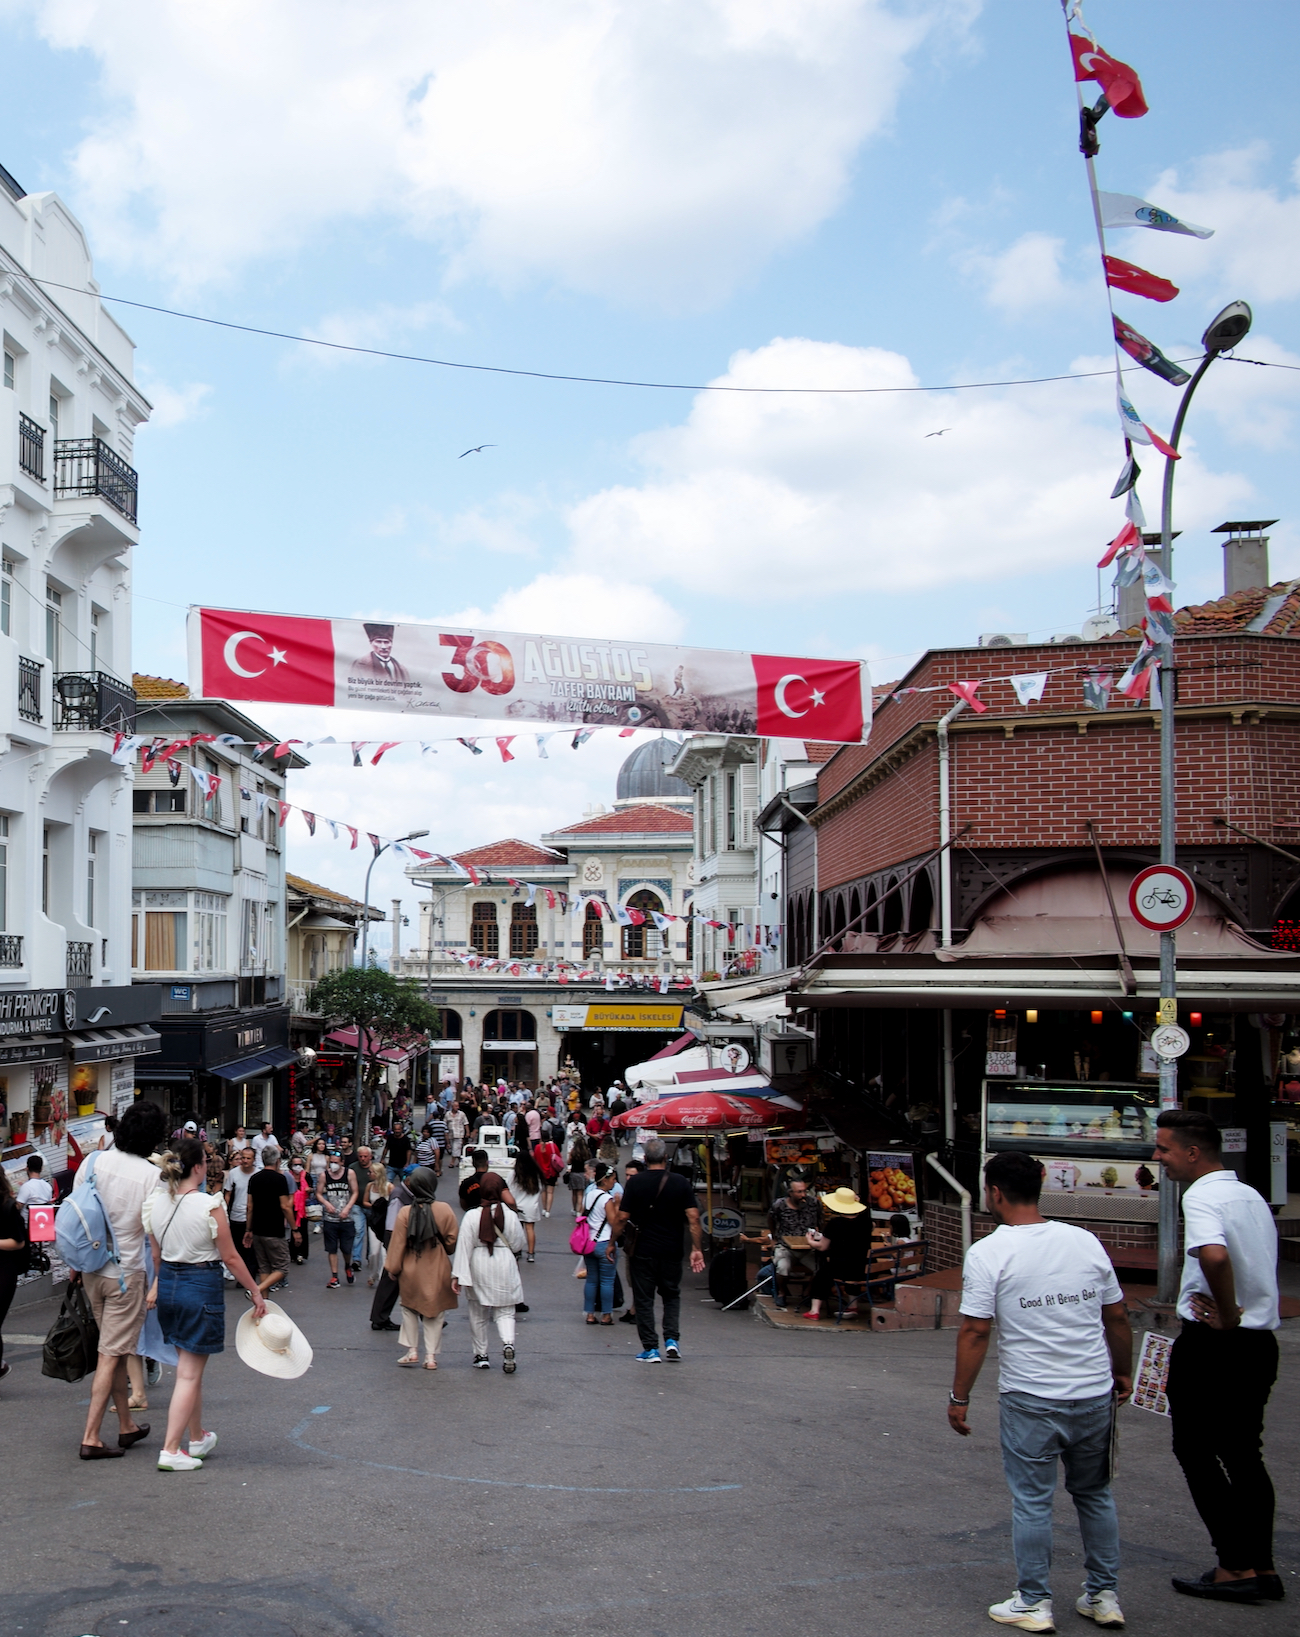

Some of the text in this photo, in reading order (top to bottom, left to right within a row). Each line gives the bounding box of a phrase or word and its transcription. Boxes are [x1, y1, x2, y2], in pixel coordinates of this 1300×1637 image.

[439, 634, 653, 695] 30 AĞUSTOS
[357, 678, 374, 686] büyük
[550, 681, 636, 702] ZAFER BAYRAMI
[566, 699, 619, 716] kutlu olsun
[174, 987, 188, 995] WC
[594, 1012, 636, 1020] BÜYÜKADA
[639, 1012, 675, 1021] İSKELESİ
[30, 1018, 52, 1032] WAFFLE
[681, 1114, 709, 1124] Coca-Cola
[739, 1113, 764, 1123] Coca-Cola
[713, 1218, 738, 1228] OMA
[1019, 1288, 1097, 1309] Good At Being Bad
